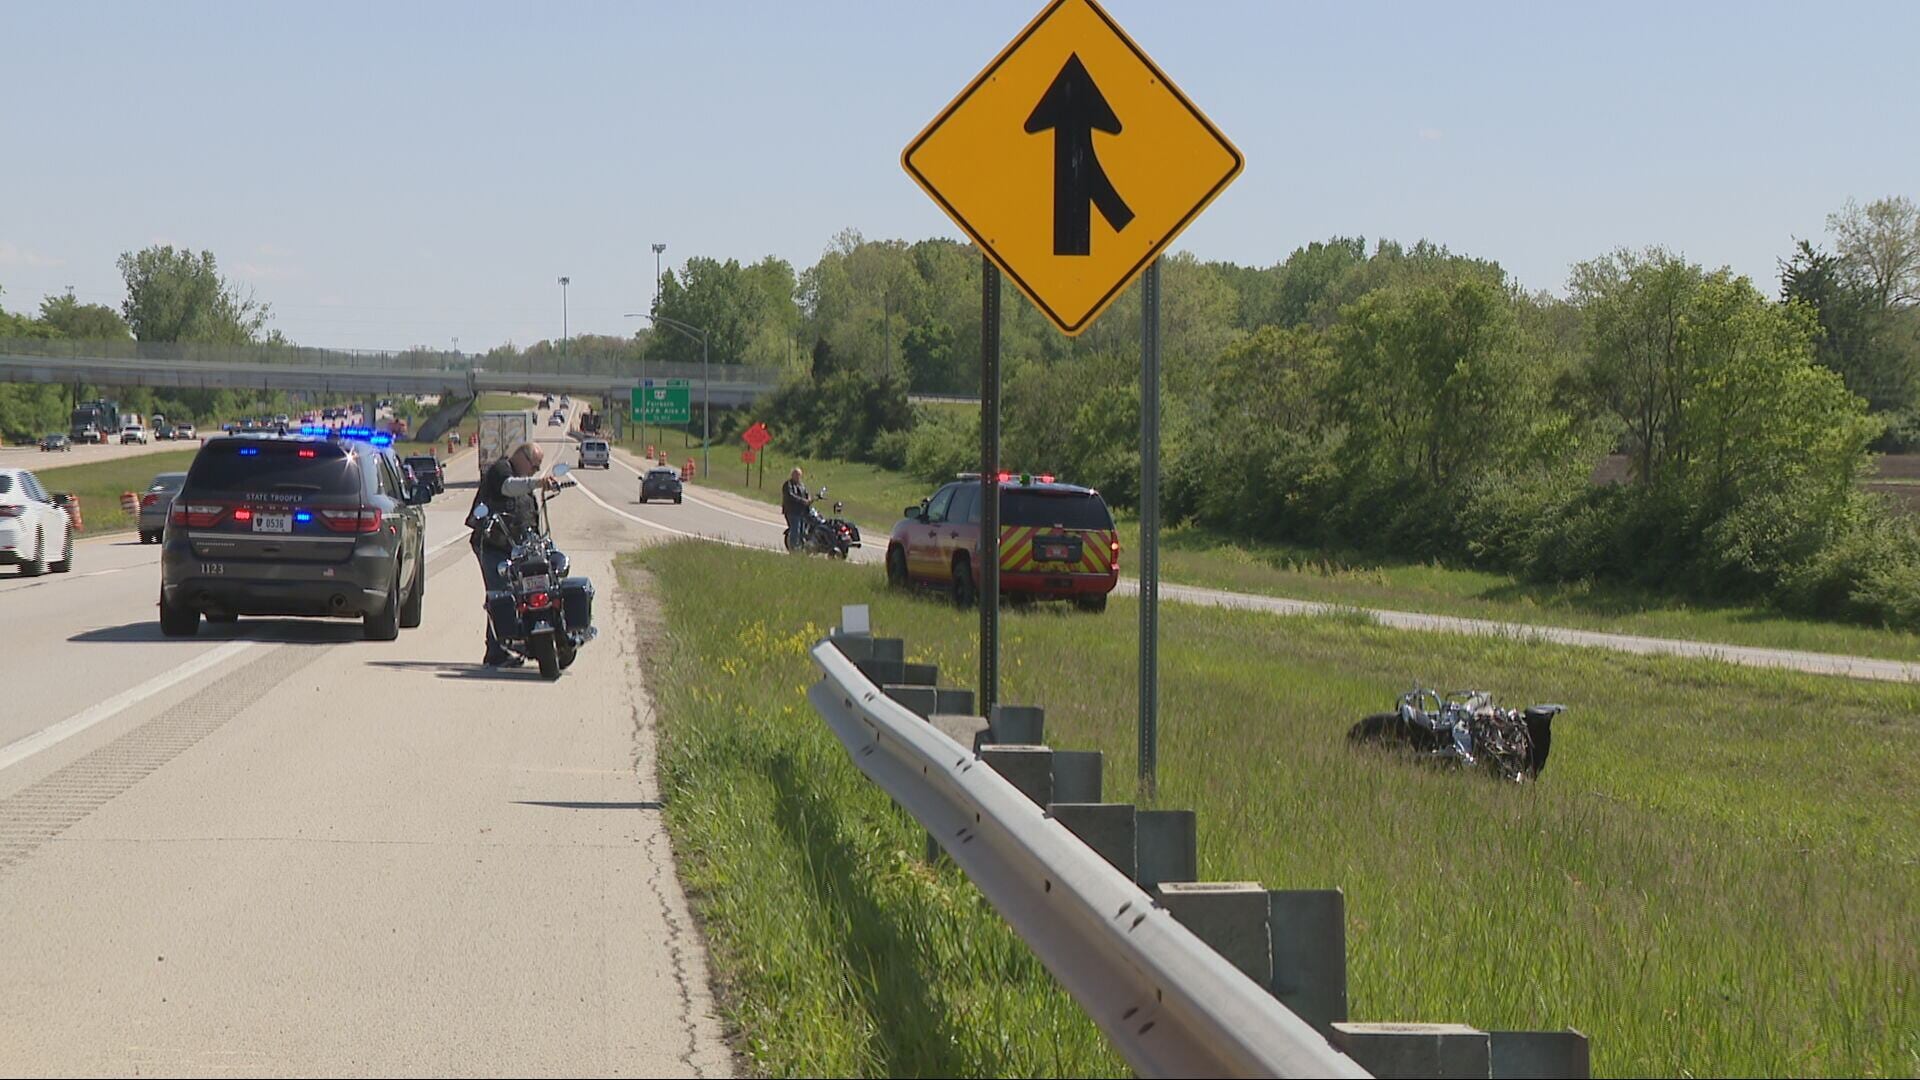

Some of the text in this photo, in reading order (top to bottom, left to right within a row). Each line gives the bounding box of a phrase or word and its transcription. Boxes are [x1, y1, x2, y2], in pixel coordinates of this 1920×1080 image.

[246, 493, 303, 502] STATE TROOPER
[200, 563, 224, 574] 1123
